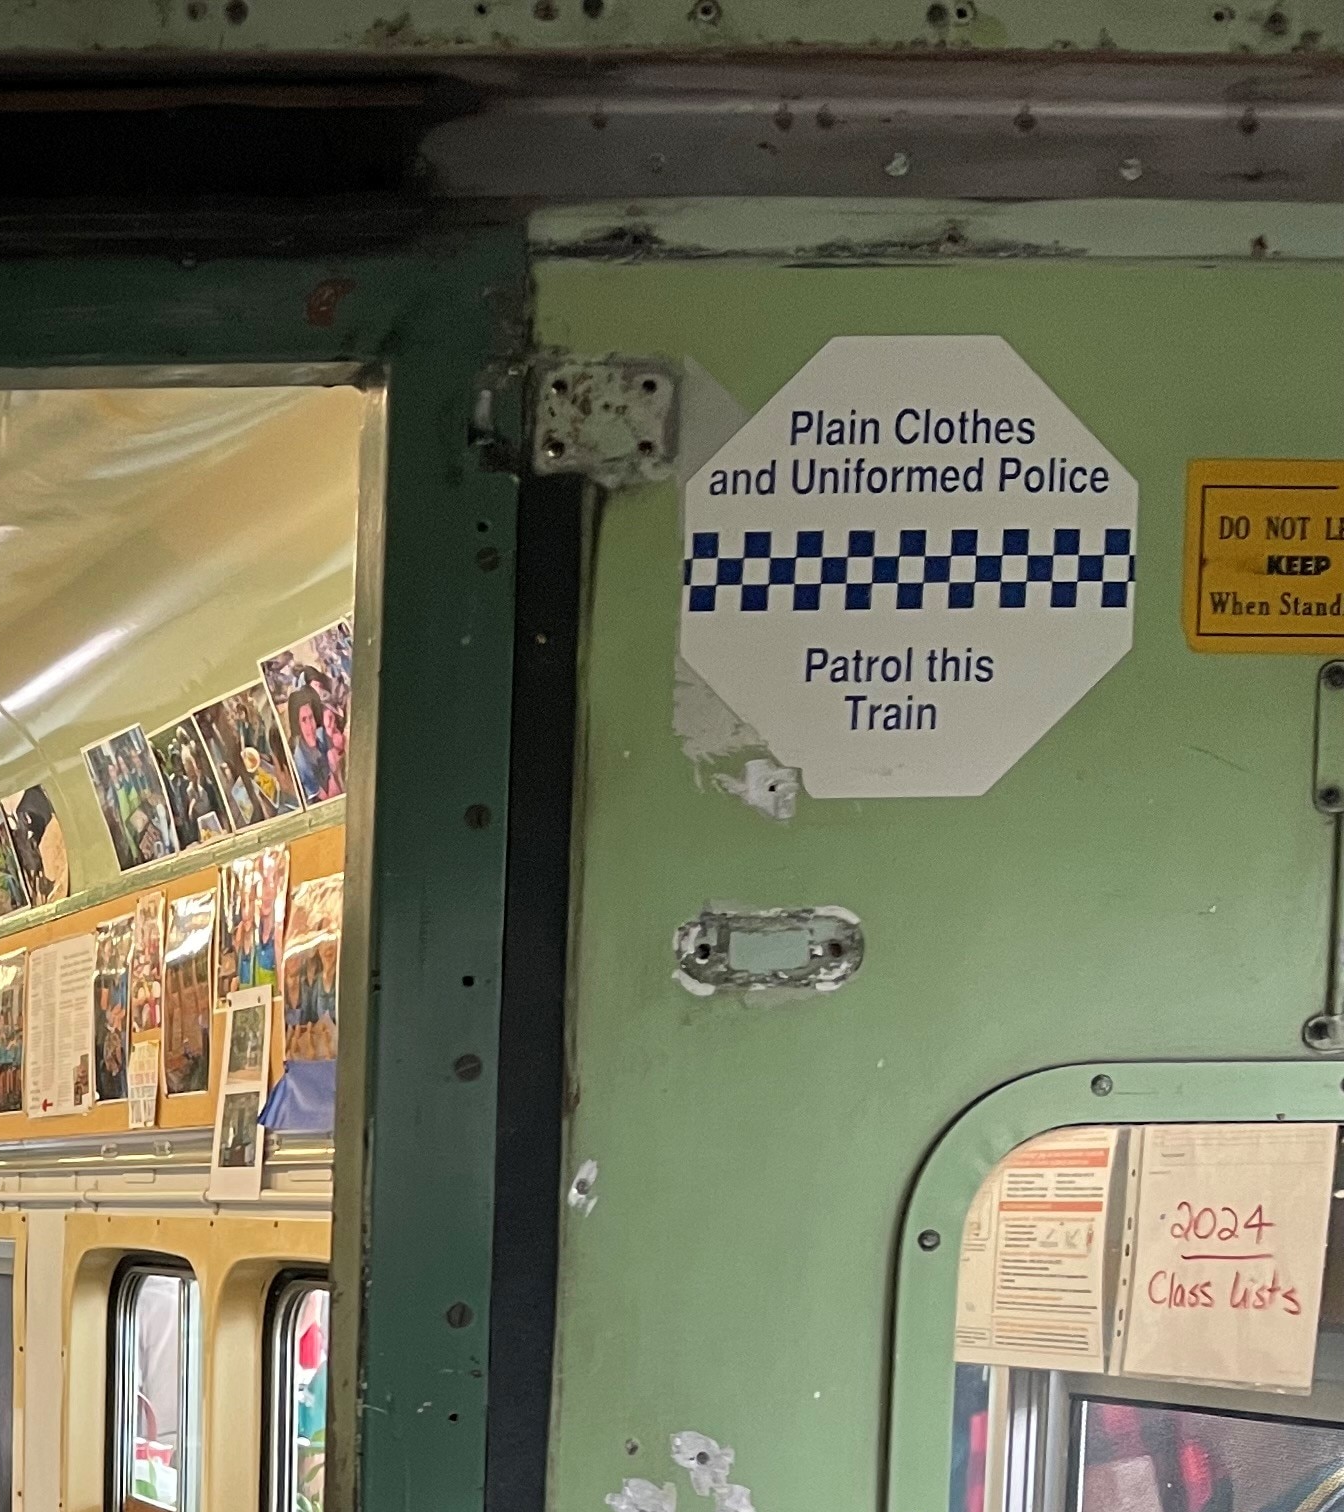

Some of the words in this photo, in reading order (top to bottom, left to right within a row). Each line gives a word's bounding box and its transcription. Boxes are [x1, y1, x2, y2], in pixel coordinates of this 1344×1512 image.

[790, 410, 880, 446] Plain
[894, 408, 1036, 445] Clothes
[709, 459, 776, 496] and
[792, 457, 984, 495] Uniformed
[999, 457, 1109, 493] Police
[1219, 515, 1250, 540] DO
[1266, 516, 1310, 541] NOT
[1266, 555, 1331, 576] KEEP
[1210, 591, 1271, 616] When
[1279, 592, 1344, 617] Stand
[805, 647, 912, 683] Patrol
[927, 648, 994, 682] this
[845, 696, 937, 730] Train
[1170, 1201, 1276, 1244] 2024
[1148, 1270, 1214, 1309] Class
